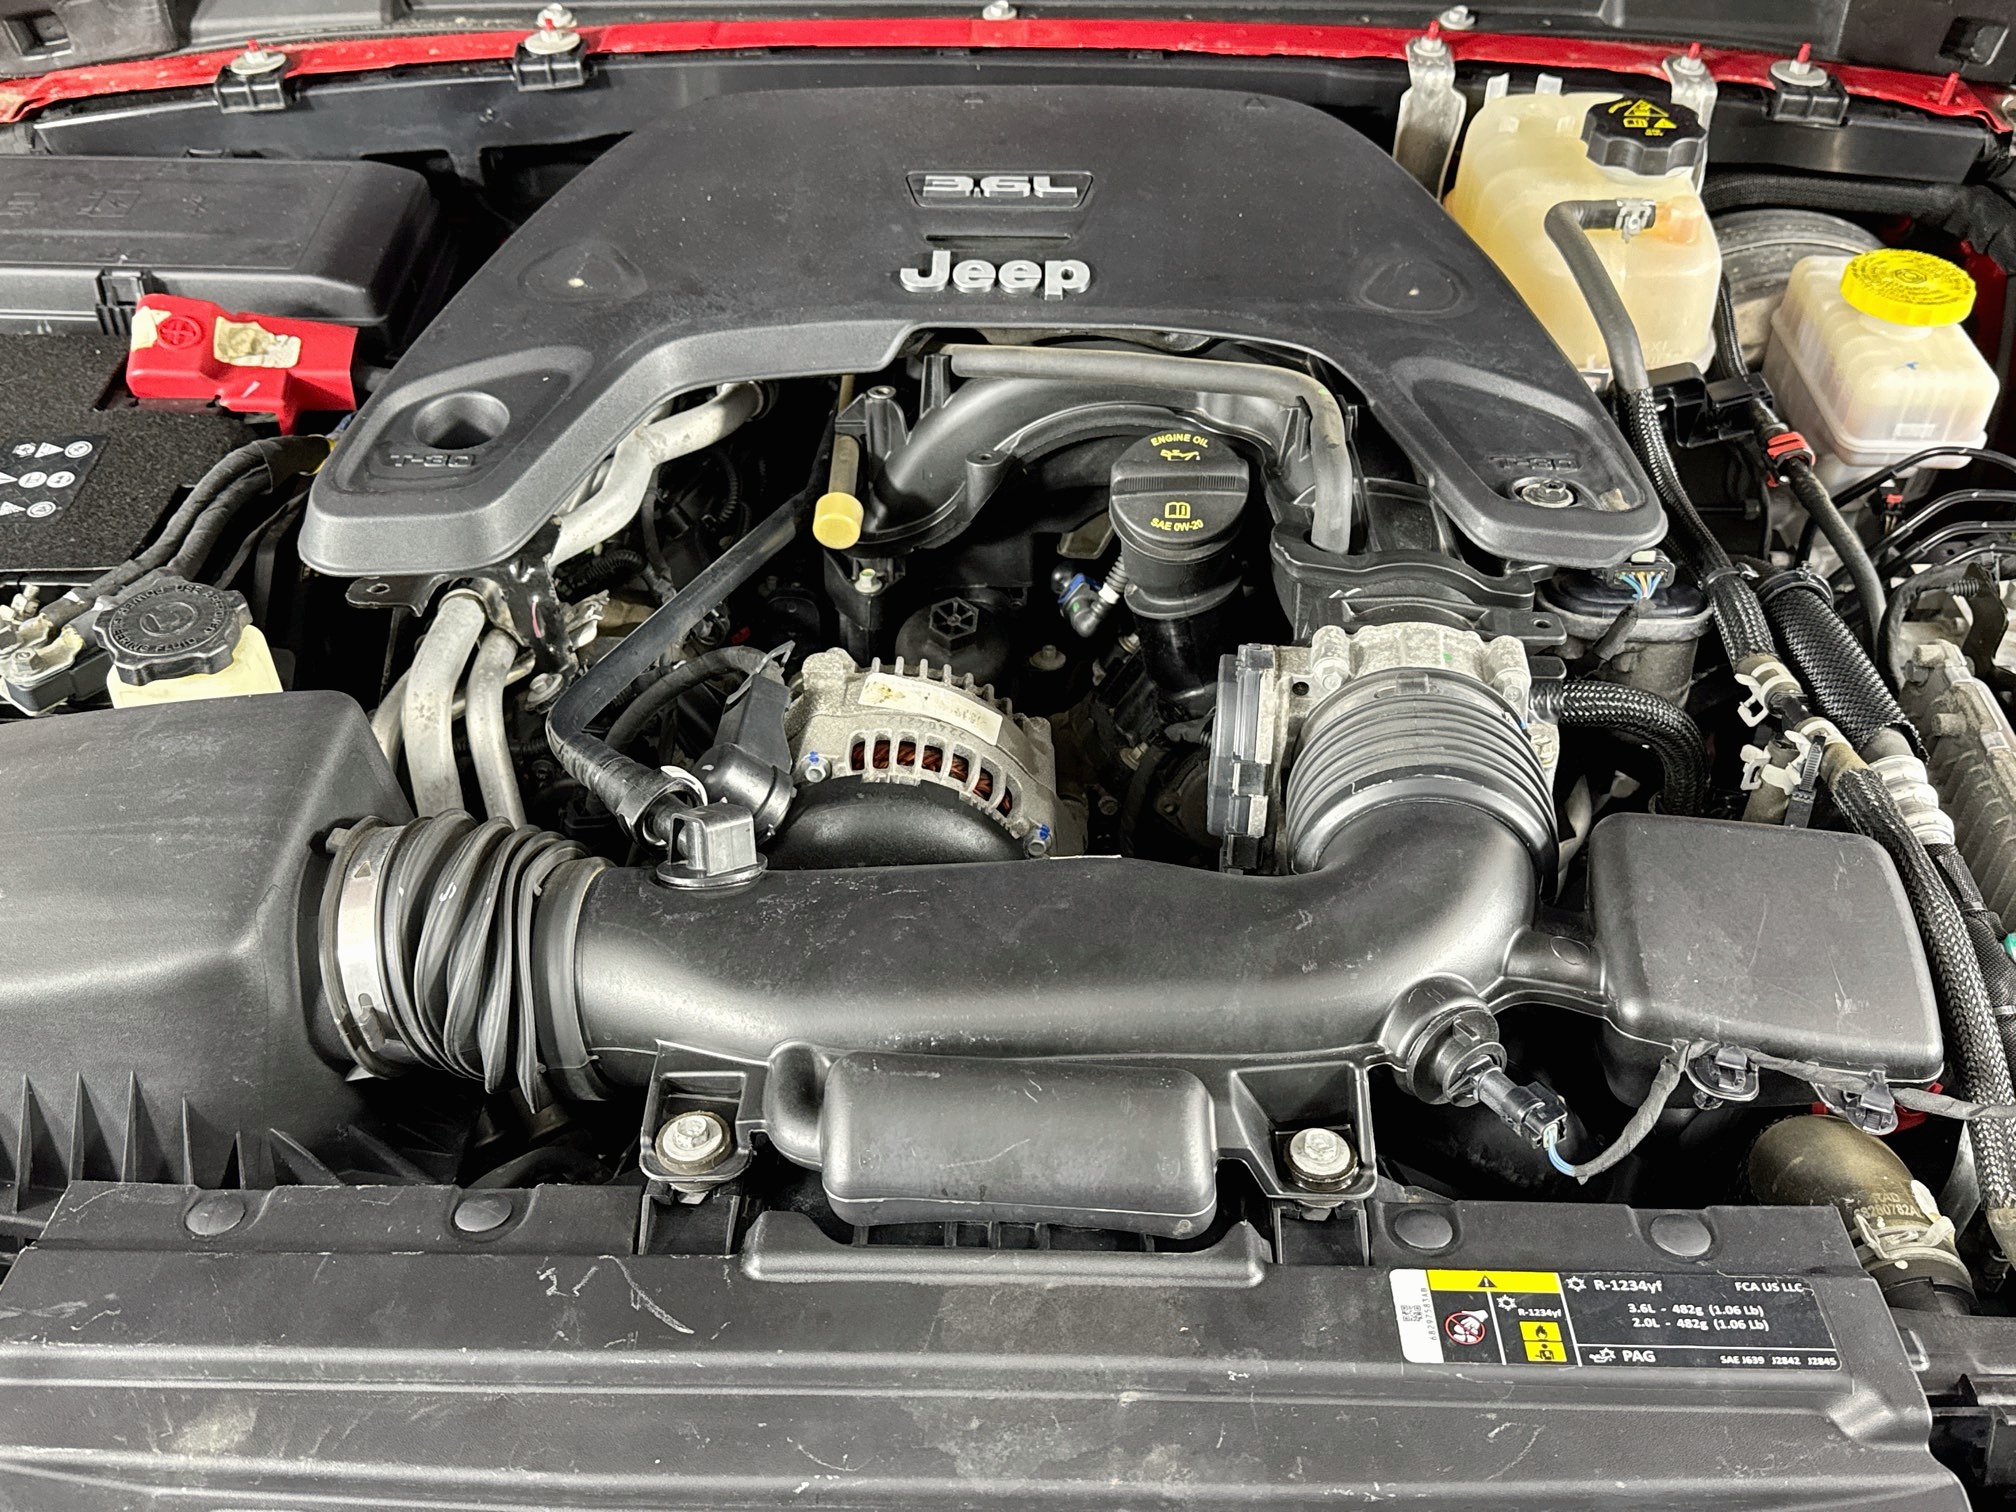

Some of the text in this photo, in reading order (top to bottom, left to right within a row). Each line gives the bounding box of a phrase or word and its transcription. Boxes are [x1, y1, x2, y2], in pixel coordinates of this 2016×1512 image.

[923, 175, 1078, 198] 3.6L
[900, 250, 1090, 300] Jeep
[1150, 434, 1208, 448] ENGINE OIL
[1150, 518, 1204, 531] SAE 0W-20
[1594, 1279, 1663, 1294] R-1234yf
[1735, 1281, 1804, 1293] FCA US LLC
[1517, 1308, 1562, 1319] R-1234yf
[1628, 1304, 1655, 1314] 3.6L
[1672, 1304, 1703, 1316] 482g
[1709, 1303, 1741, 1316] (1.06
[1744, 1305, 1764, 1317] Lb)
[1633, 1318, 1660, 1328] 2.0L
[1676, 1318, 1708, 1331] 482g
[1714, 1318, 1746, 1331] (1.06
[1748, 1319, 1769, 1331] Lb)
[1622, 1350, 1656, 1363] PAG
[1720, 1355, 1740, 1364] SAE
[1742, 1355, 1765, 1364] J639
